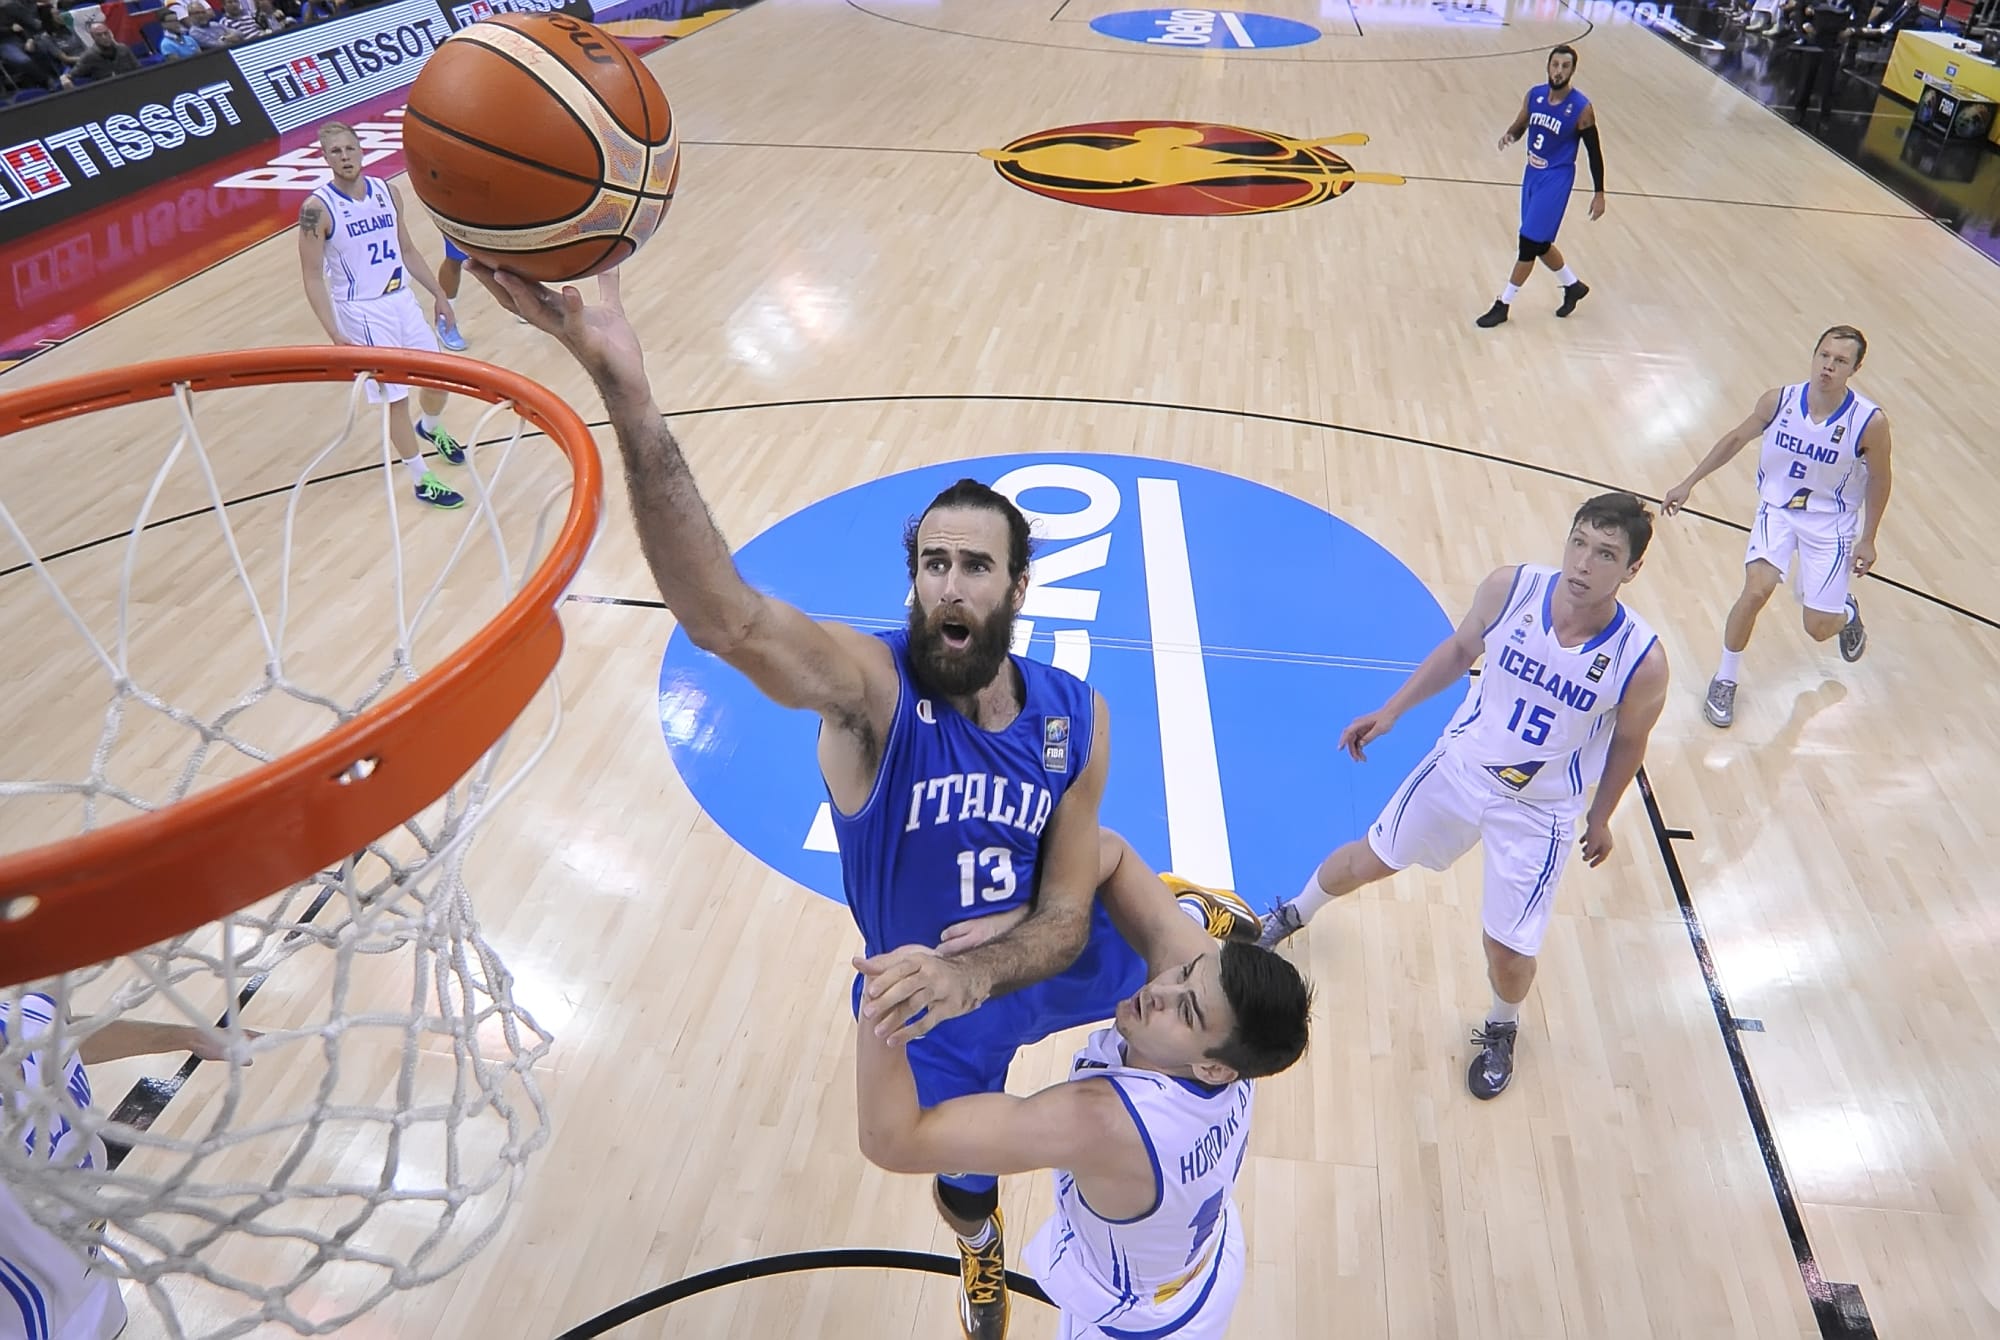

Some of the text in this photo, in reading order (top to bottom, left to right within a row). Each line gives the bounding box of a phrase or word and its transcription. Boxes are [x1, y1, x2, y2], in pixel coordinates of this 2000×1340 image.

[317, 18, 437, 85] TISSOT
[44, 80, 242, 178] TISSOT
[1530, 112, 1562, 135] ITALIA
[1533, 134, 1544, 150] 3
[346, 214, 394, 239] ICELAND
[367, 240, 396, 265] 24
[1775, 431, 1840, 465] ICELAND
[1789, 460, 1807, 480] 6
[1499, 645, 1598, 713] ICELAND
[1507, 698, 1556, 746] 15
[905, 773, 1052, 837] ITALIA
[957, 847, 1017, 907] 13
